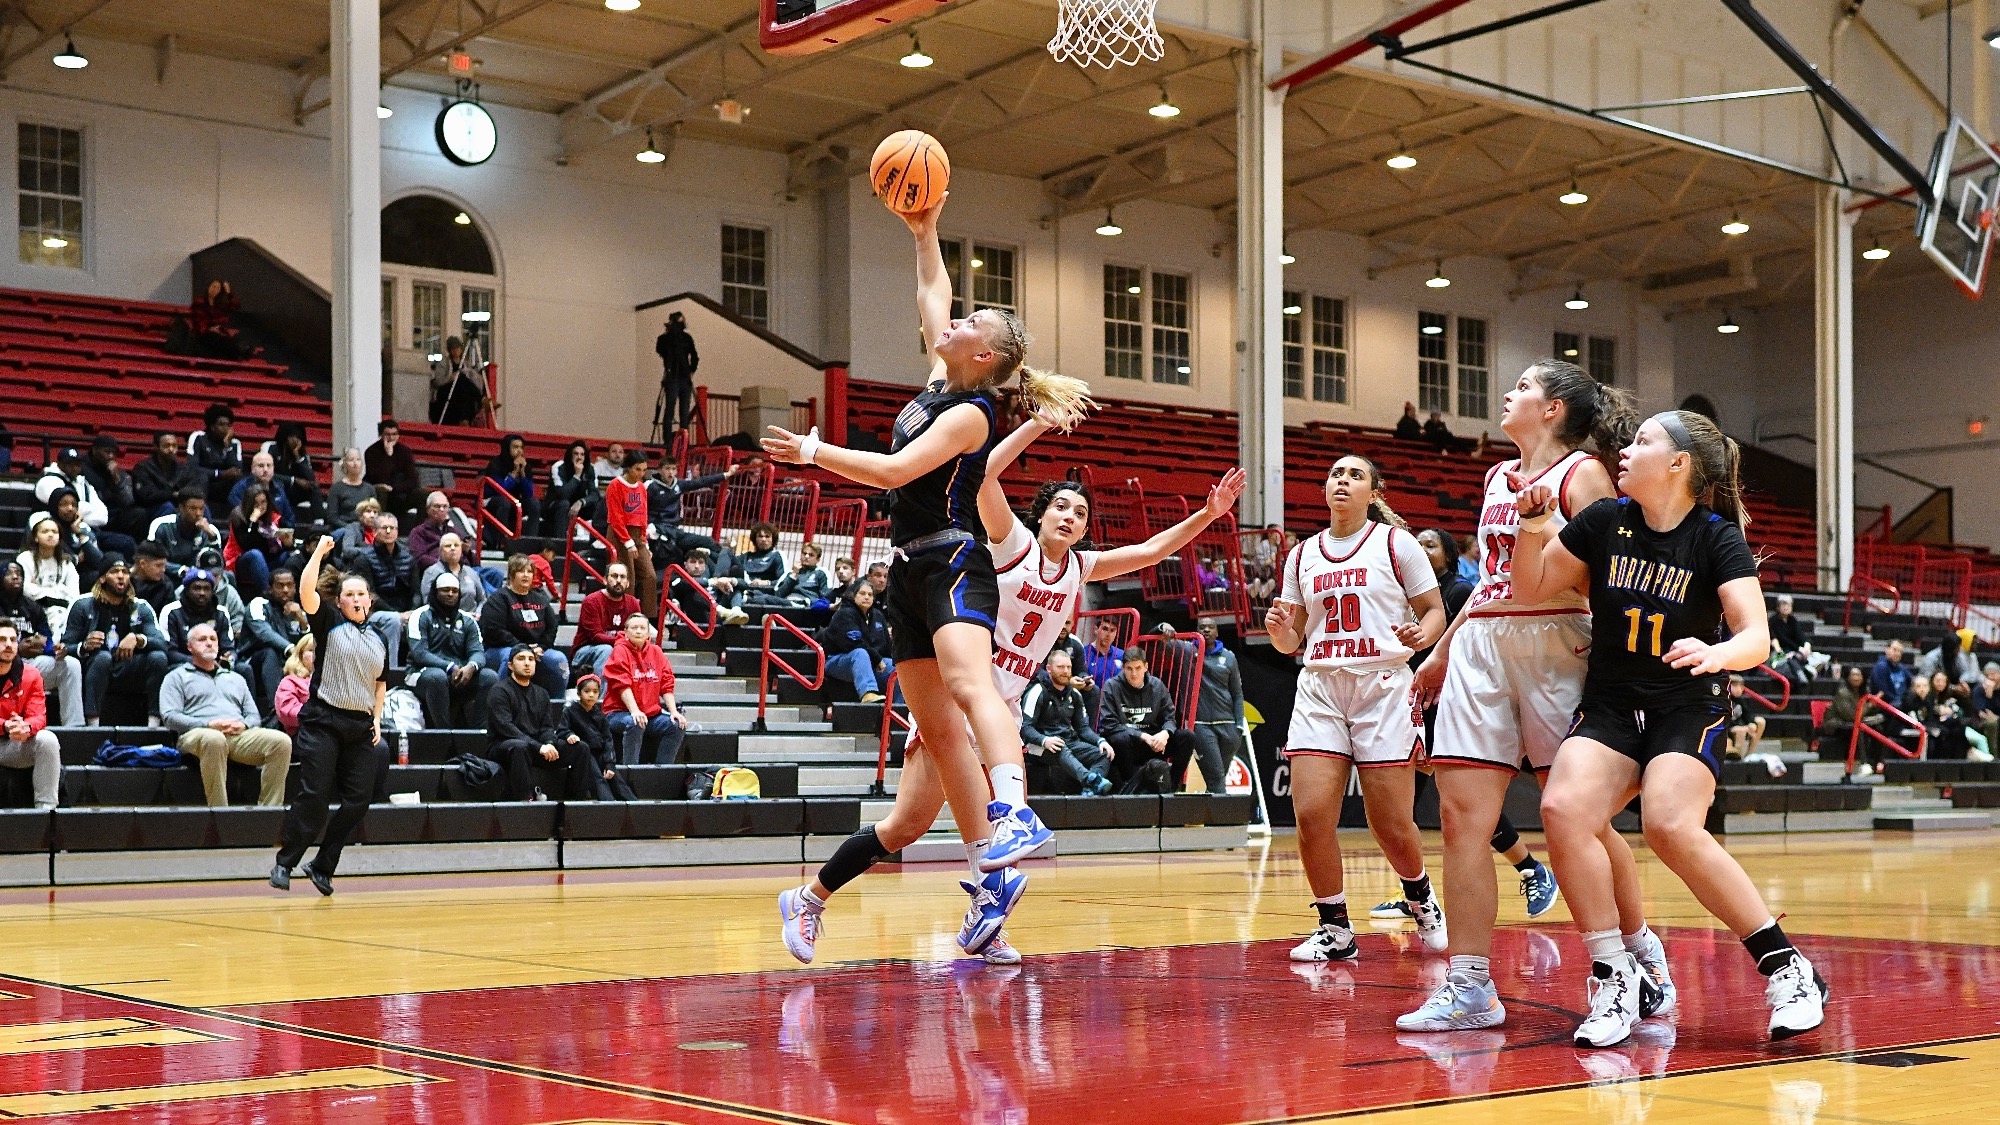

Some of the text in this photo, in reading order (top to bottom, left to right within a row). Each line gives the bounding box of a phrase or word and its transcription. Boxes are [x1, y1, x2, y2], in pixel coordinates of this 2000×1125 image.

[1481, 502, 1520, 527] NORT
[1016, 581, 1067, 612] NORTH
[1313, 568, 1368, 594] NORTH
[1607, 554, 1694, 604] NORTH PARK
[1011, 611, 1044, 648] 3
[1322, 593, 1362, 633] 20
[1623, 604, 1667, 657] 11
